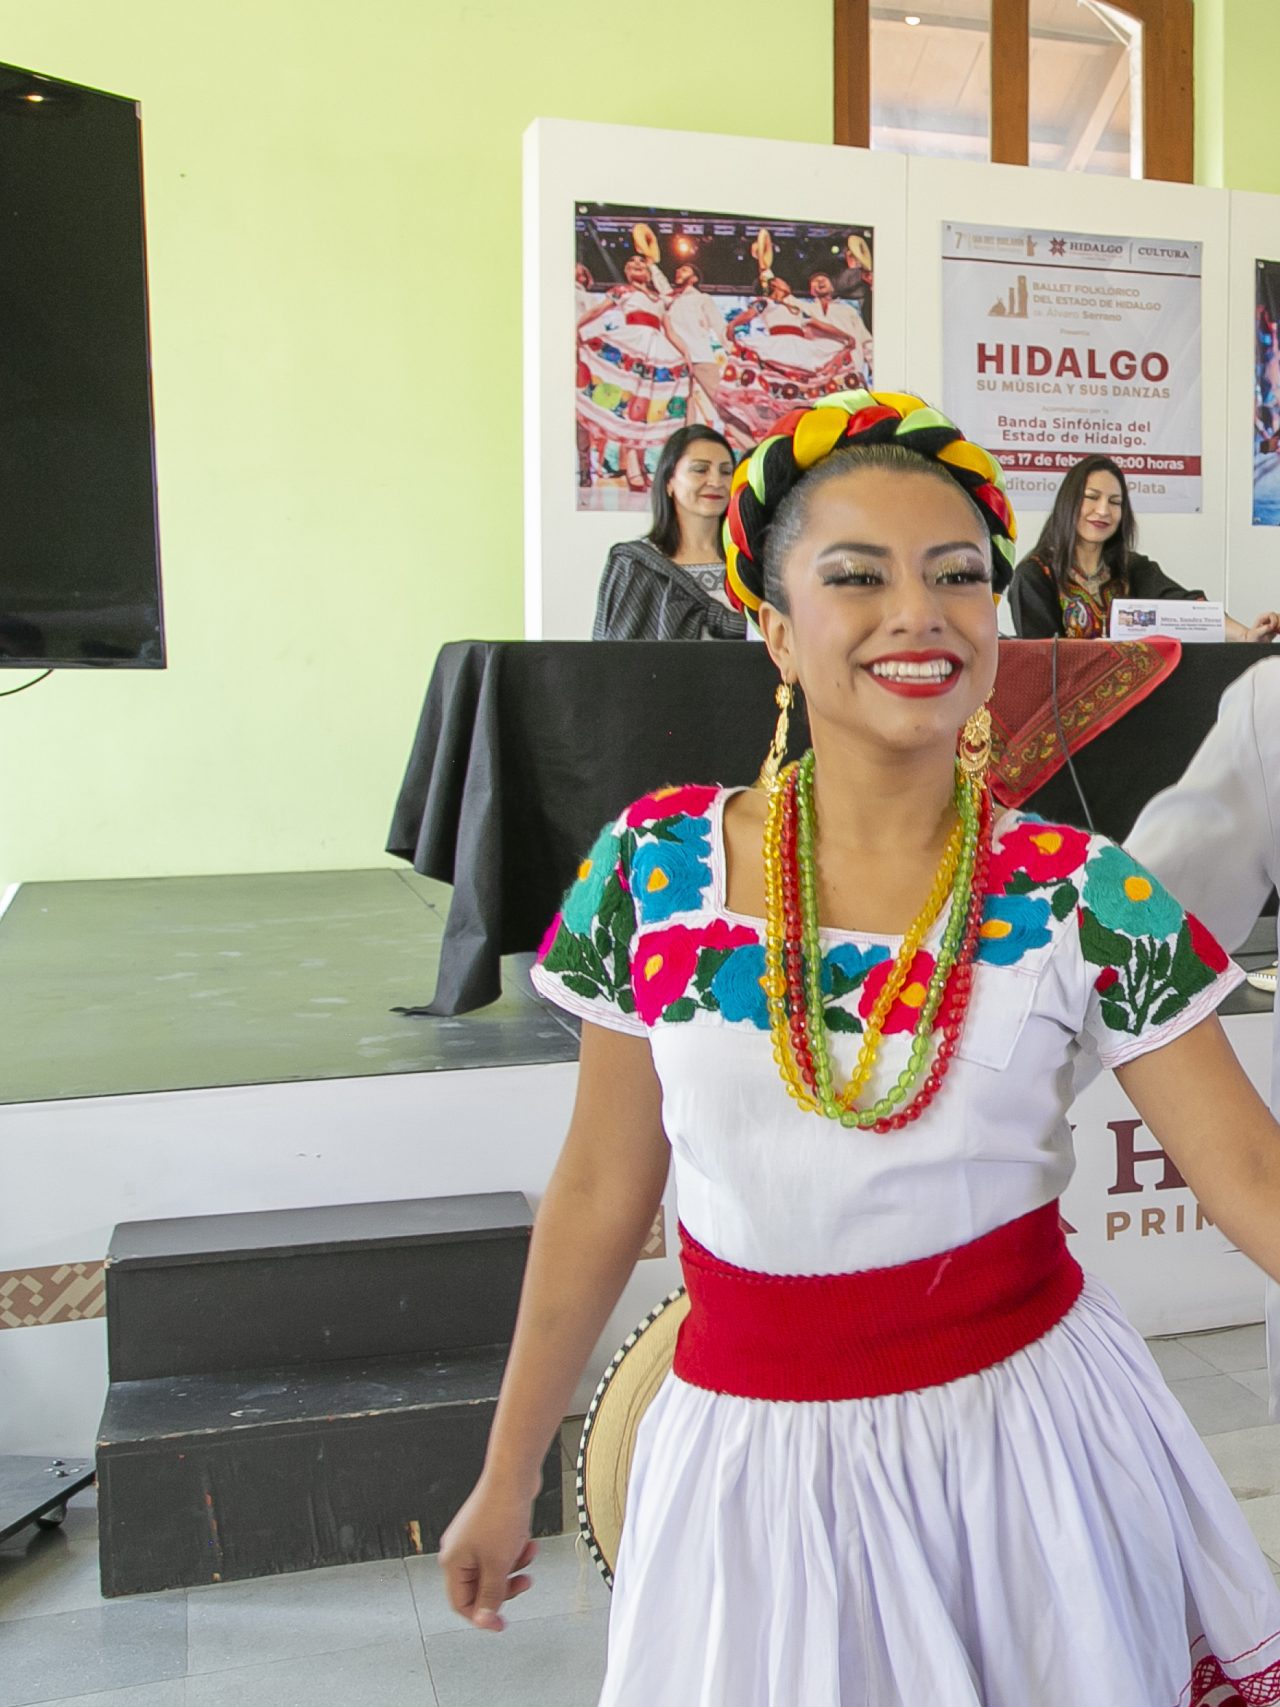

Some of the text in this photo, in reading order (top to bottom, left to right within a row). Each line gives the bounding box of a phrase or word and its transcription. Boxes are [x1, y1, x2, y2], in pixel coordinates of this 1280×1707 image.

[1069, 241, 1123, 254] HIDALGO
[1138, 246, 1190, 259] CULTURA
[1032, 282, 1071, 293] BALLET
[1033, 294, 1162, 311] DEL ESTADO DE HIDALGO
[1082, 310, 1122, 321] Serrano
[977, 343, 1169, 382] HIDALGO
[976, 378, 1170, 399] SU MÚSICA Y SUS DANZAS
[998, 416, 1151, 433] Banda Sinfónica del
[1002, 430, 1147, 447] Estado de Hidalgo.
[1017, 453, 1032, 465] 17
[1034, 454, 1053, 466] de
[1147, 457, 1184, 470] horas
[1006, 478, 1166, 494] ditorio Plata
